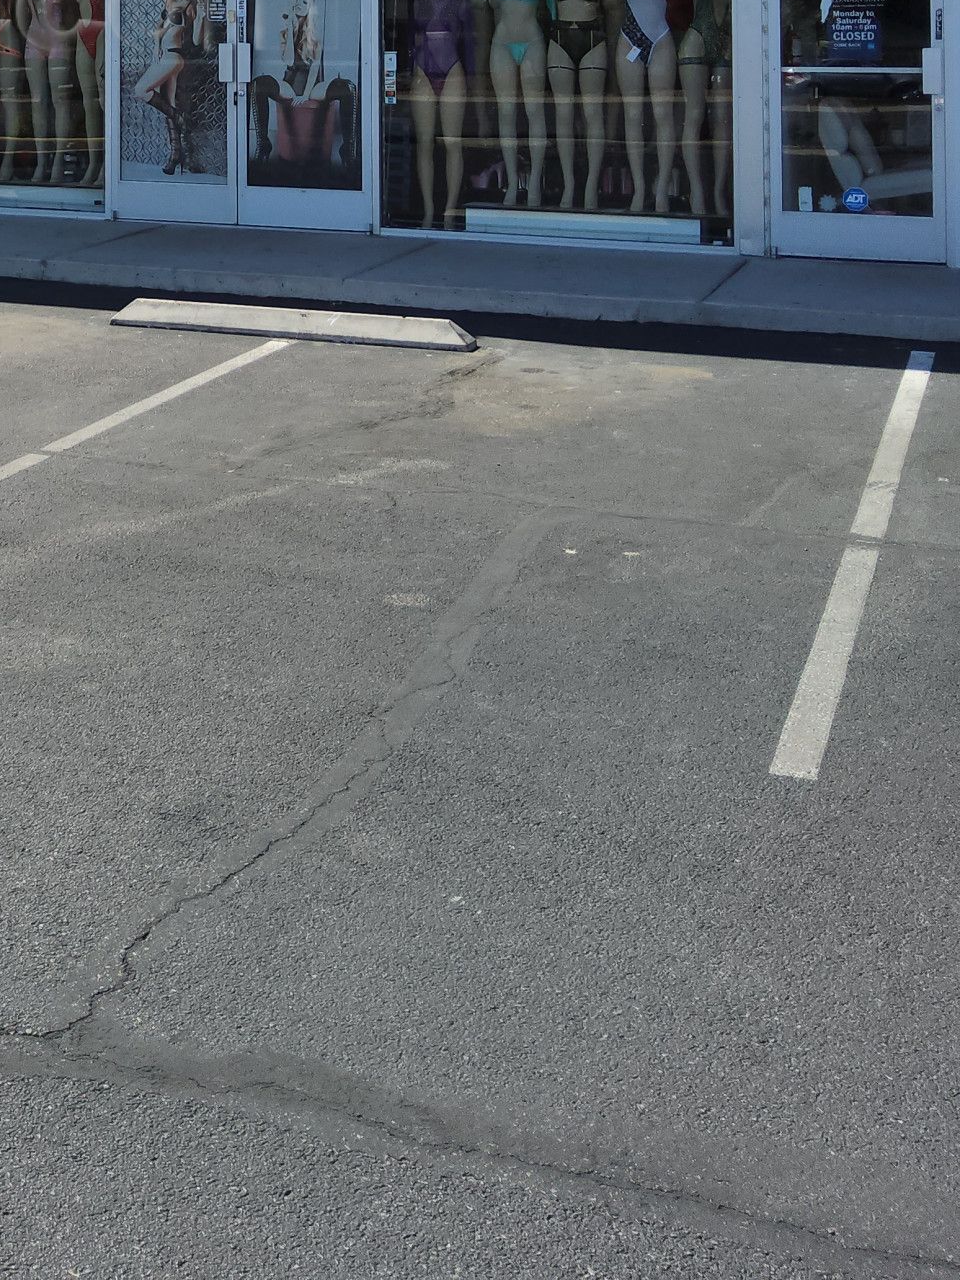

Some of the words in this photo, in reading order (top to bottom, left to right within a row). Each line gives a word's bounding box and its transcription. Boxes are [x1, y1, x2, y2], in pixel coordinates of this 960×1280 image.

[833, 10, 865, 19] Monday
[836, 17, 871, 26] Saturday
[833, 31, 875, 41] CLOSED
[846, 194, 866, 204] ADT
